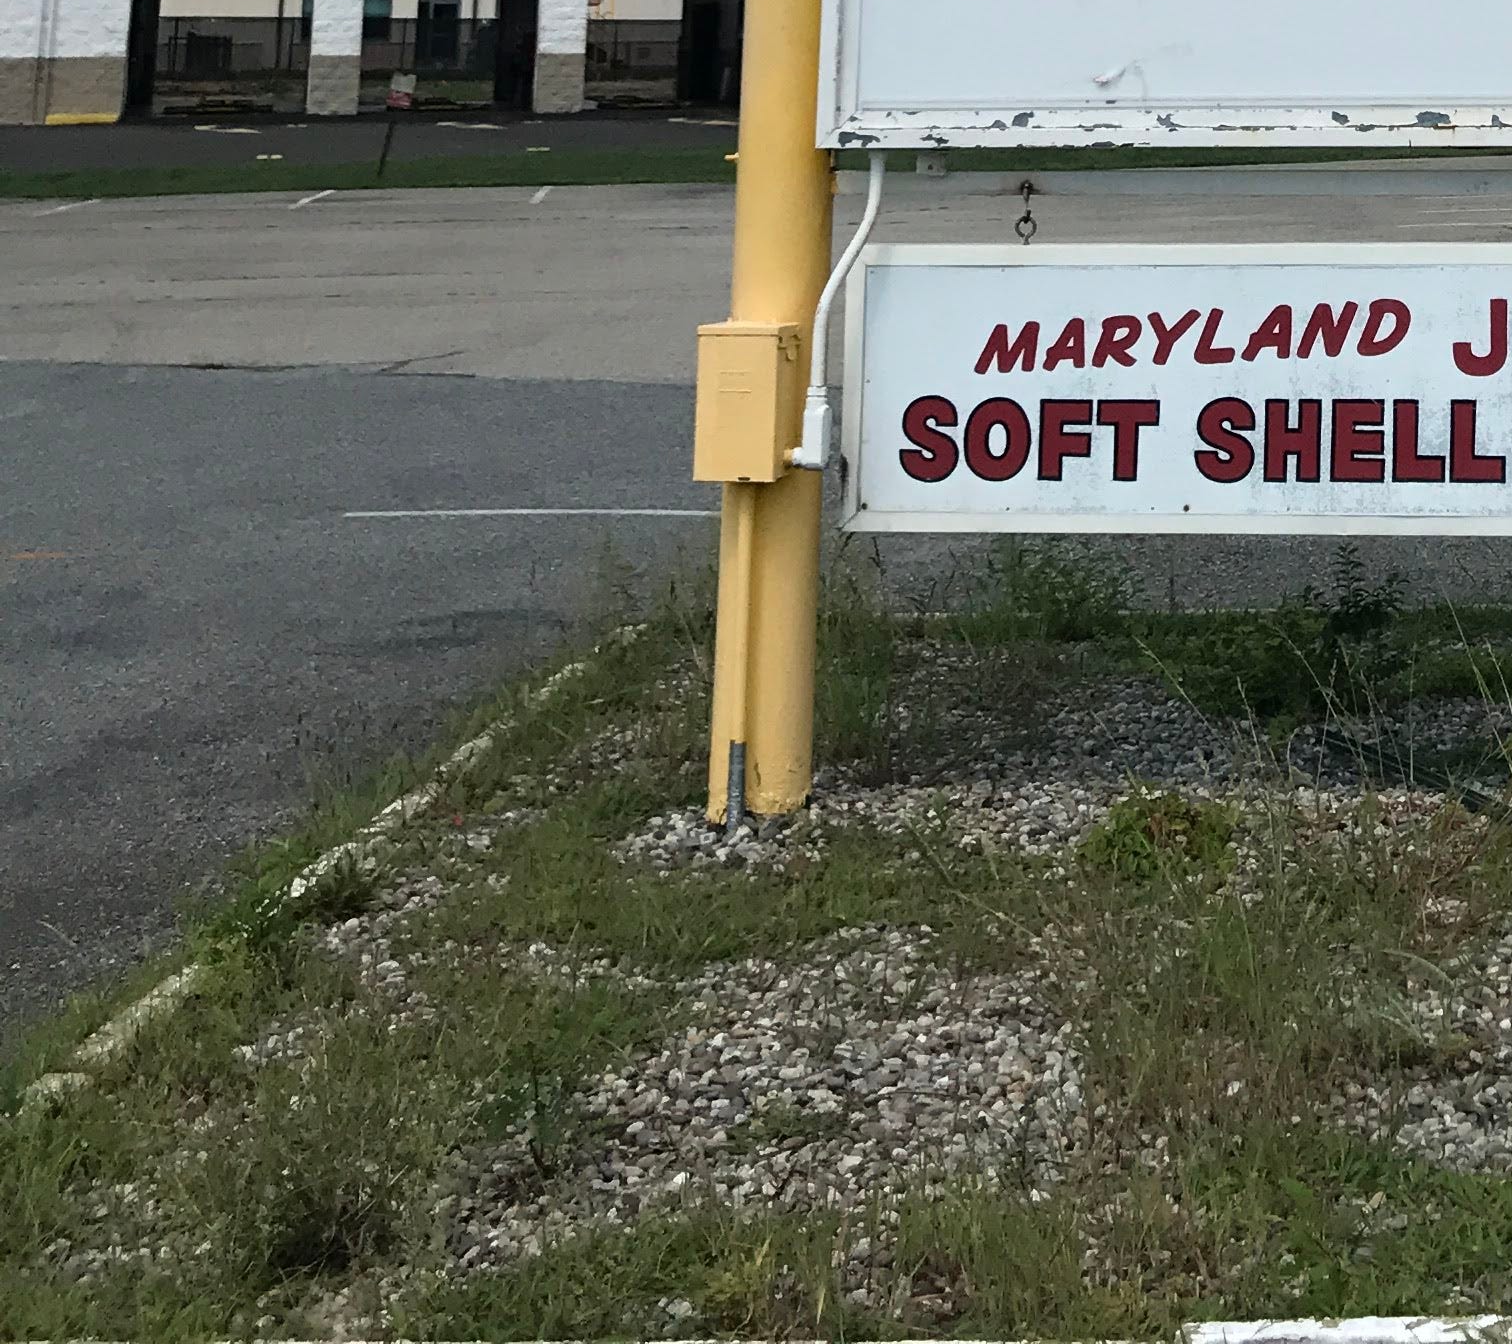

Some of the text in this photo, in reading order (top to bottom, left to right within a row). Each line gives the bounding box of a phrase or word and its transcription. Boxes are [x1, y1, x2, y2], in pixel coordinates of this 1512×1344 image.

[974, 298, 1411, 374] MARYLAND
[899, 394, 1160, 482] SOFT
[1195, 397, 1506, 484] SHELL
